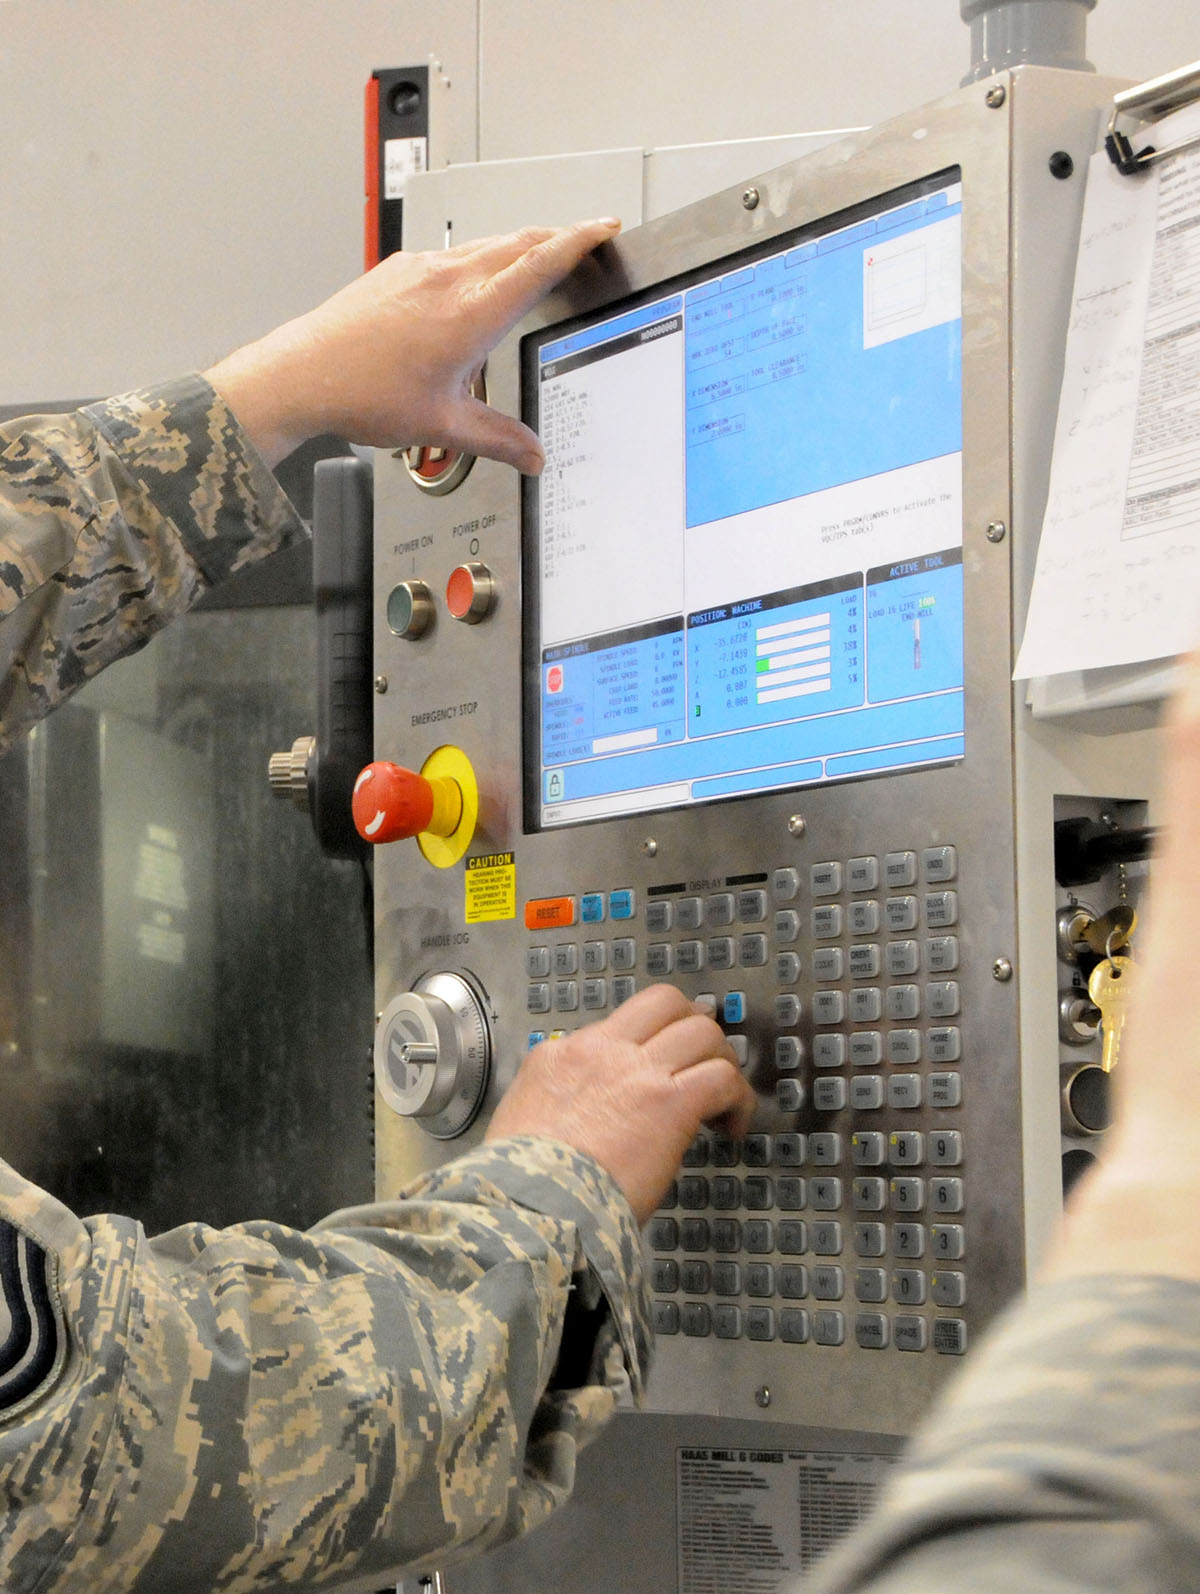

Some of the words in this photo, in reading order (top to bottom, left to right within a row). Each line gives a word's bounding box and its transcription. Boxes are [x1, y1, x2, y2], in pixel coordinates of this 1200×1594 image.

[452, 520, 480, 538] POWER
[481, 514, 497, 529] OFF
[393, 539, 420, 555] POWER
[421, 533, 434, 549] ON
[890, 561, 919, 577] ACTIVE
[924, 556, 945, 570] TOOL
[731, 600, 763, 616] MACHINE
[411, 706, 457, 727] EMERGENCY
[459, 701, 479, 716] STOP
[469, 853, 511, 869] CAUTION
[689, 879, 722, 891] DISPLAY
[536, 906, 560, 921] RESET
[421, 934, 451, 948] HANDLE
[452, 932, 471, 946] JOG
[529, 956, 539, 968] F1
[557, 953, 567, 966] F2
[585, 950, 596, 964] F3
[614, 947, 625, 961] F4
[850, 949, 870, 960] ORIENT
[816, 1144, 824, 1156] E
[860, 1140, 868, 1157] 7
[898, 1139, 906, 1158] 8
[937, 1138, 946, 1157] 9
[817, 1185, 825, 1200] K
[861, 1186, 869, 1201] 4
[899, 1186, 907, 1202] 5
[938, 1186, 947, 1203] 6
[862, 1231, 869, 1249] 1
[900, 1231, 908, 1249] 2
[939, 1231, 948, 1250] 3
[818, 1275, 828, 1288] W
[901, 1277, 909, 1295] 0
[935, 1337, 959, 1349] ENTER
[681, 1450, 709, 1461] HAAS
[711, 1451, 736, 1462] MILL
[739, 1452, 747, 1462] G
[749, 1452, 784, 1463] CODES
